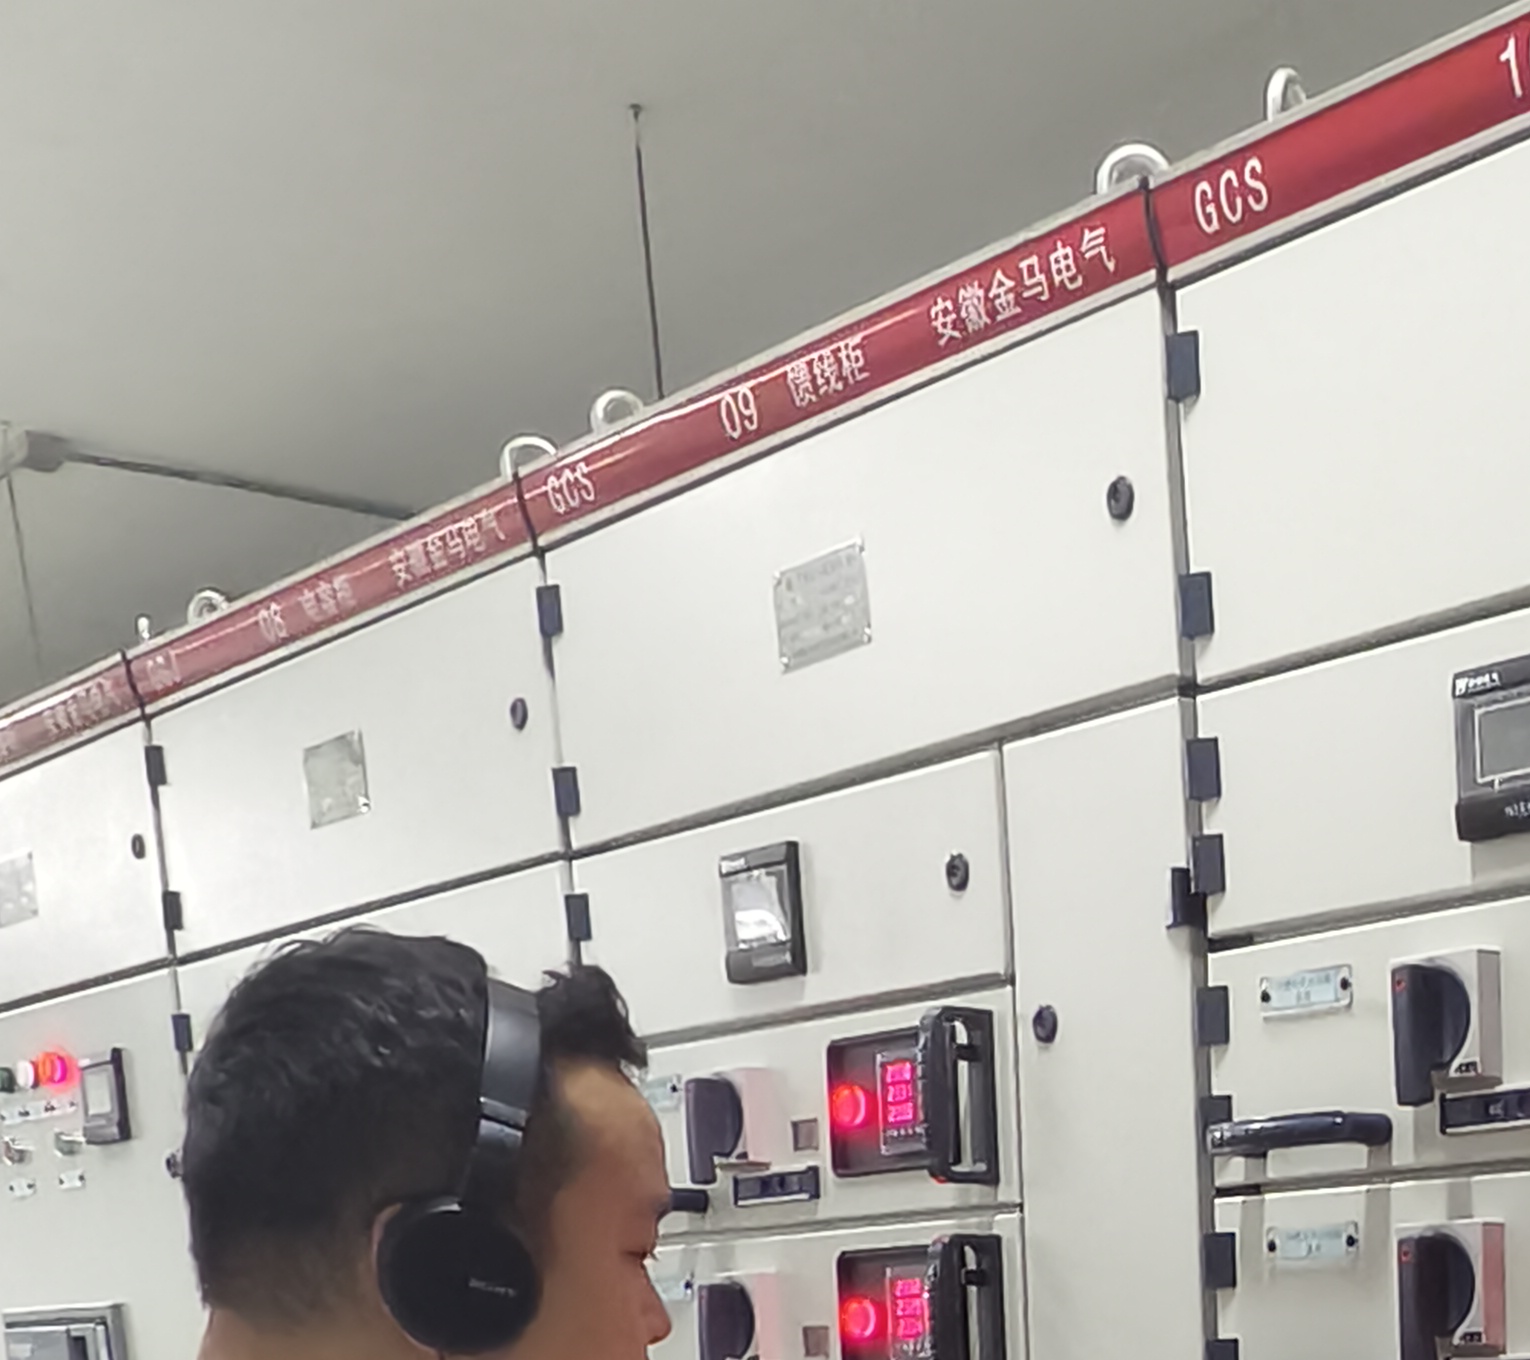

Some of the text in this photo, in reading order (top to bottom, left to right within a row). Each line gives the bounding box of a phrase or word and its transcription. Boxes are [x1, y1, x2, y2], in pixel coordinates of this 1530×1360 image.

[1194, 156, 1269, 235] GCS
[546, 461, 596, 515] GCS
[720, 384, 758, 440] 09
[929, 226, 1116, 347] 安徽金马电气
